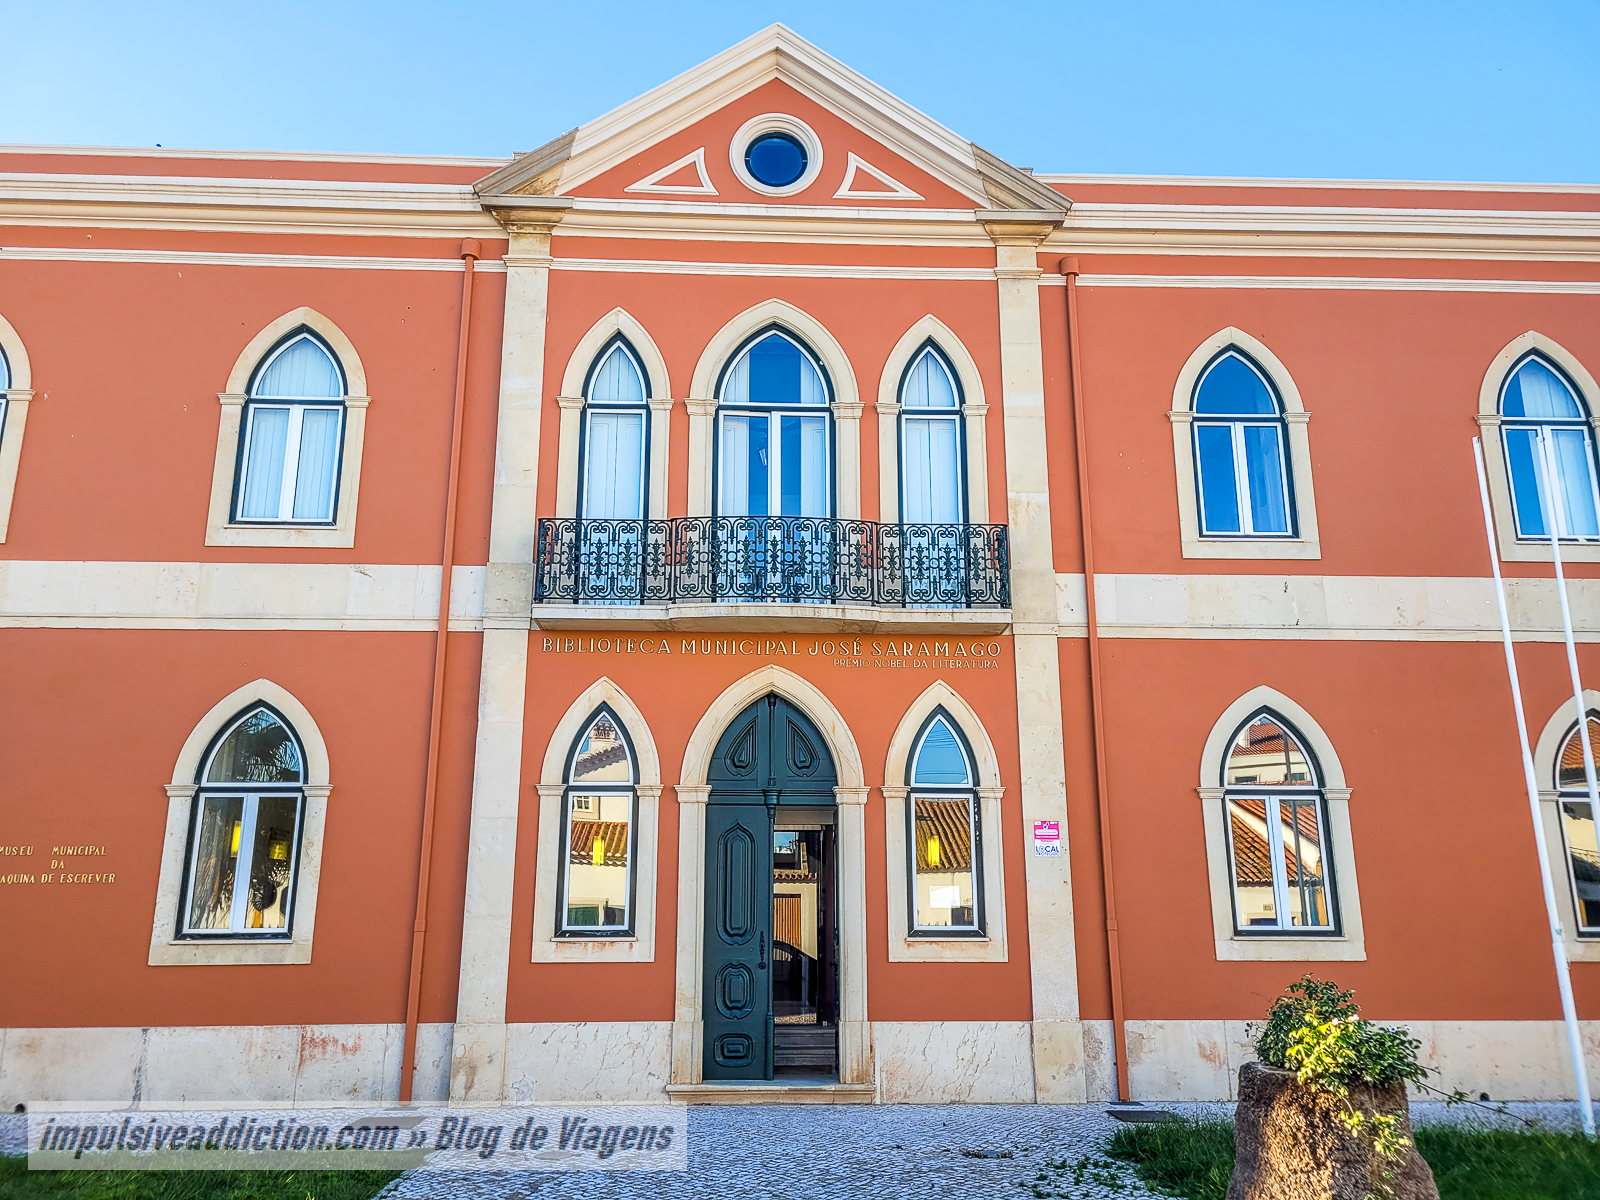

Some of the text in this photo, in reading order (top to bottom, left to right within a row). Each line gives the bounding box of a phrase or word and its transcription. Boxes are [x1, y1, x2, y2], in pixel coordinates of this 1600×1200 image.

[542, 637, 1001, 657] BIBLIOTECA MUNICIPAL JOSÉ SARAMAGO
[874, 659, 909, 668] NOBEL
[913, 659, 928, 668] DA
[932, 659, 999, 669] LITERATURA
[51, 845, 107, 856] MUNICIPAL
[51, 859, 65, 870] DA
[40, 873, 55, 884] DE
[59, 873, 116, 884] ESCREVER
